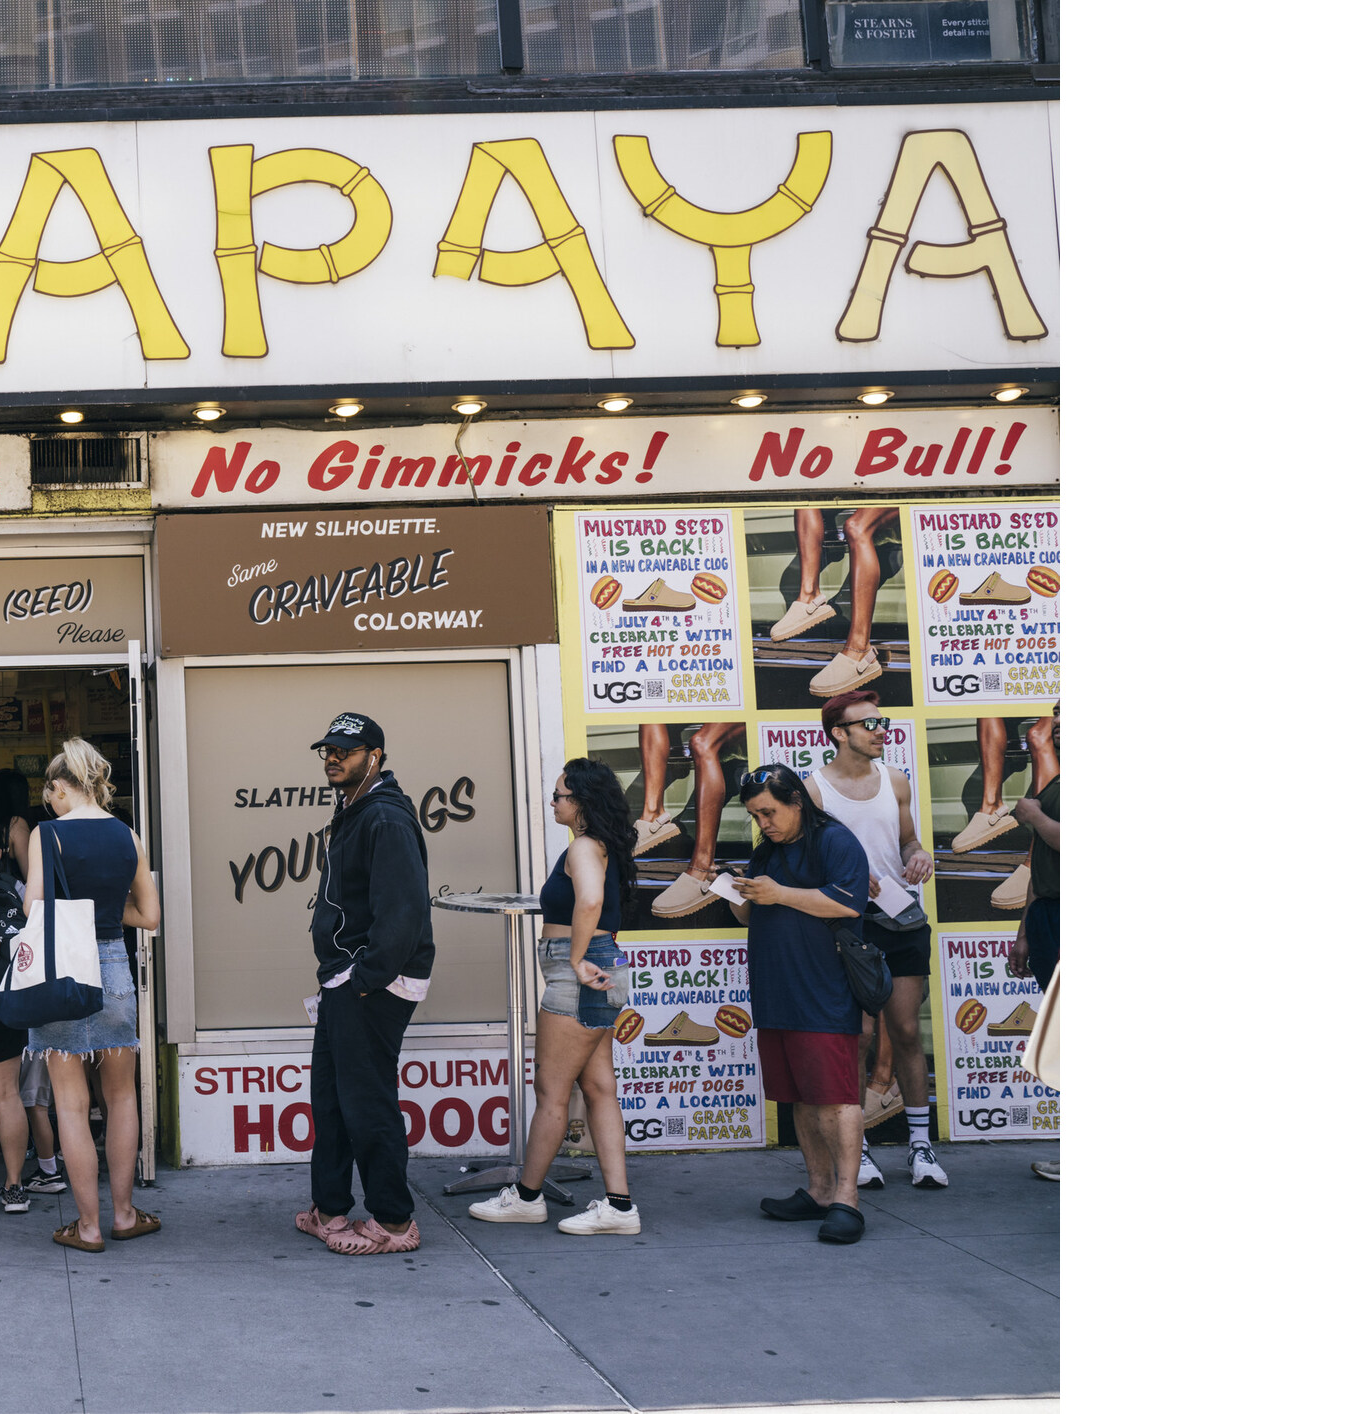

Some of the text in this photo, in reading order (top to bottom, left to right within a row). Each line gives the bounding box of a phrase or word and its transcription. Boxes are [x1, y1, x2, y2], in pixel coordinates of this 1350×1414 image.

[854, 18, 913, 28] STEARNS
[942, 19, 965, 27] Every
[855, 29, 916, 38] & FOSTER
[749, 422, 1027, 481] No Bull!
[190, 431, 670, 498] No Gimmicks!
[261, 518, 441, 539] NEW SILHOUETTE.
[584, 518, 724, 537] MUSTARD SEED
[919, 511, 1058, 531] MUSTARD SEED
[609, 537, 703, 557] IS BACK!
[945, 530, 1038, 550] IS BACK!
[586, 557, 728, 573] IN A NEW CRAVEABLE CLOG
[923, 554, 934, 567] IN
[936, 554, 945, 567] A
[948, 553, 971, 566] NEW
[974, 552, 1036, 566] CRAVEABLE
[227, 559, 279, 588] Same
[249, 548, 455, 625] CRAVEABLE
[2, 578, 94, 623] (SEED)
[353, 609, 484, 631] COLORWAY.
[615, 616, 648, 629] JULY
[673, 615, 681, 628] &
[952, 609, 985, 622] JULY
[1008, 609, 1017, 621] &
[57, 622, 125, 644] Please
[589, 628, 733, 643] CELEBRATE WITH
[928, 622, 1060, 637] CELEBRATE WIT
[602, 644, 722, 658] FREE HOT DOGS
[940, 636, 1057, 651] FREE HOT DOGS
[592, 658, 734, 673] FIND A LOCATION
[931, 651, 1060, 666] FIND A LOCATIO
[671, 672, 726, 688] GRAY'S
[1008, 664, 1060, 680] GRAY'S
[593, 681, 643, 704] UGG
[932, 674, 980, 696] UGG
[667, 688, 730, 703] PAPAYA
[767, 728, 906, 747] MUSTA ED
[792, 750, 813, 768] IS
[624, 948, 748, 967] USTARD SEED
[632, 967, 729, 989] IS BACK!
[973, 961, 994, 979] IS
[950, 981, 1041, 997] IN A NEW CRAVE
[633, 992, 658, 1006] NEW
[661, 989, 725, 1006] CRAVEABLE
[980, 1041, 1013, 1054] JULY
[636, 1051, 671, 1064] JULY
[695, 1050, 704, 1062] &
[955, 1056, 1023, 1069] CELEBRA
[194, 1059, 536, 1096] STRIC OURME
[708, 1063, 756, 1077] WITH
[967, 1071, 1008, 1084] FREE
[622, 1079, 745, 1095] FREE HOT DOGS
[957, 1086, 991, 1100] FIND
[1000, 1086, 1013, 1099] A
[656, 1097, 670, 1109] A
[679, 1094, 757, 1109] LOCATION
[1037, 1100, 1060, 1115] GR
[693, 1108, 748, 1125] GRAY'S
[958, 1107, 1008, 1131] UGG
[233, 1101, 313, 1153] HO
[688, 1124, 752, 1141] PAPAYA
